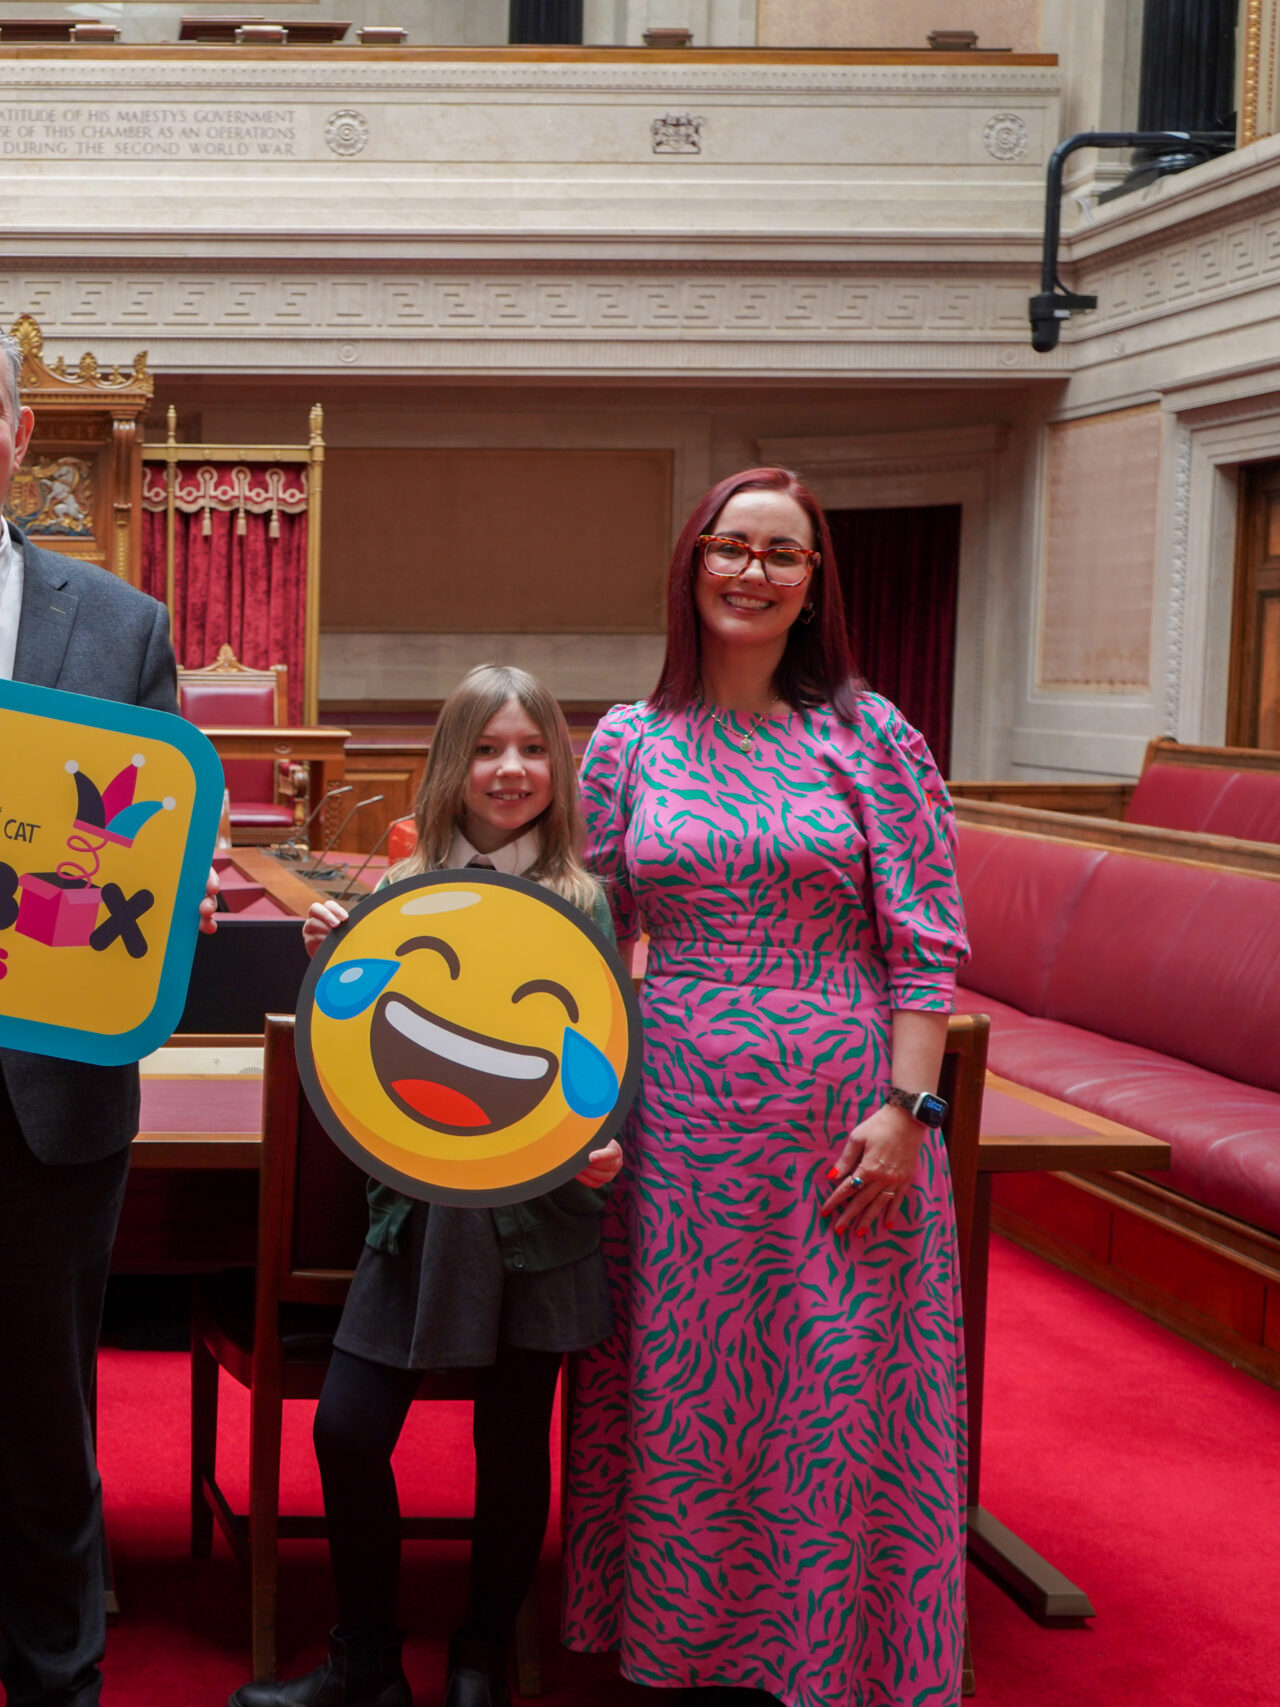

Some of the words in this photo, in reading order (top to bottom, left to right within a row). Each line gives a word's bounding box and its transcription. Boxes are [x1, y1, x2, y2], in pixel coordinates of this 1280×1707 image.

[62, 109, 83, 122] OF
[87, 109, 111, 122] HIS
[193, 109, 297, 123] GOVERNMENT
[16, 125, 36, 138] OF
[43, 125, 76, 138] THIS
[80, 125, 153, 139] CHAMBER
[157, 126, 175, 139] AS
[179, 126, 201, 139] AN
[206, 126, 297, 139] OPERATIONS
[2, 141, 68, 155] DURING
[76, 141, 105, 155] THE
[115, 141, 181, 155] SECOND
[188, 142, 250, 155] WORLD
[256, 142, 297, 156] WAR
[4, 818, 41, 843] CAT
